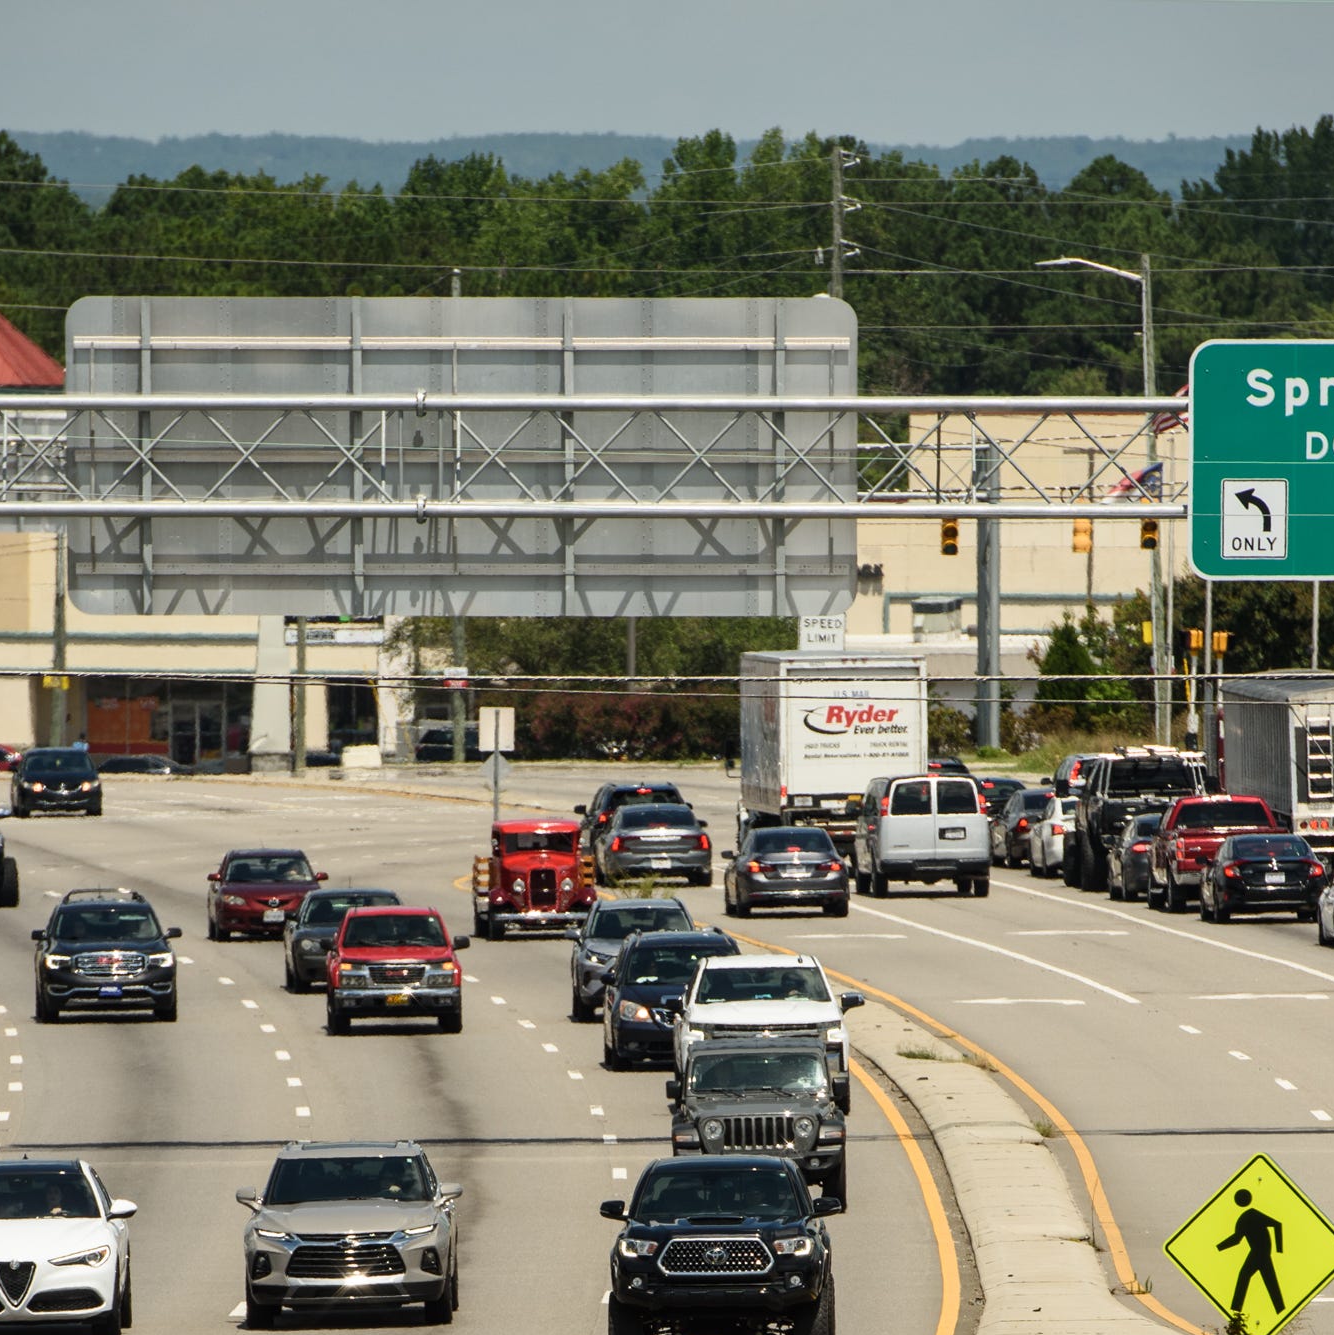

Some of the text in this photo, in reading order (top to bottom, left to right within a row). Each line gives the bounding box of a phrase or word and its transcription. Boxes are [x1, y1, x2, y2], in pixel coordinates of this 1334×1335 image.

[1232, 536, 1277, 551] ONLY
[803, 618, 842, 629] SPEED
[807, 633, 837, 644] LIMIT
[826, 704, 898, 727] Ryder
[854, 725, 875, 735] Ever
